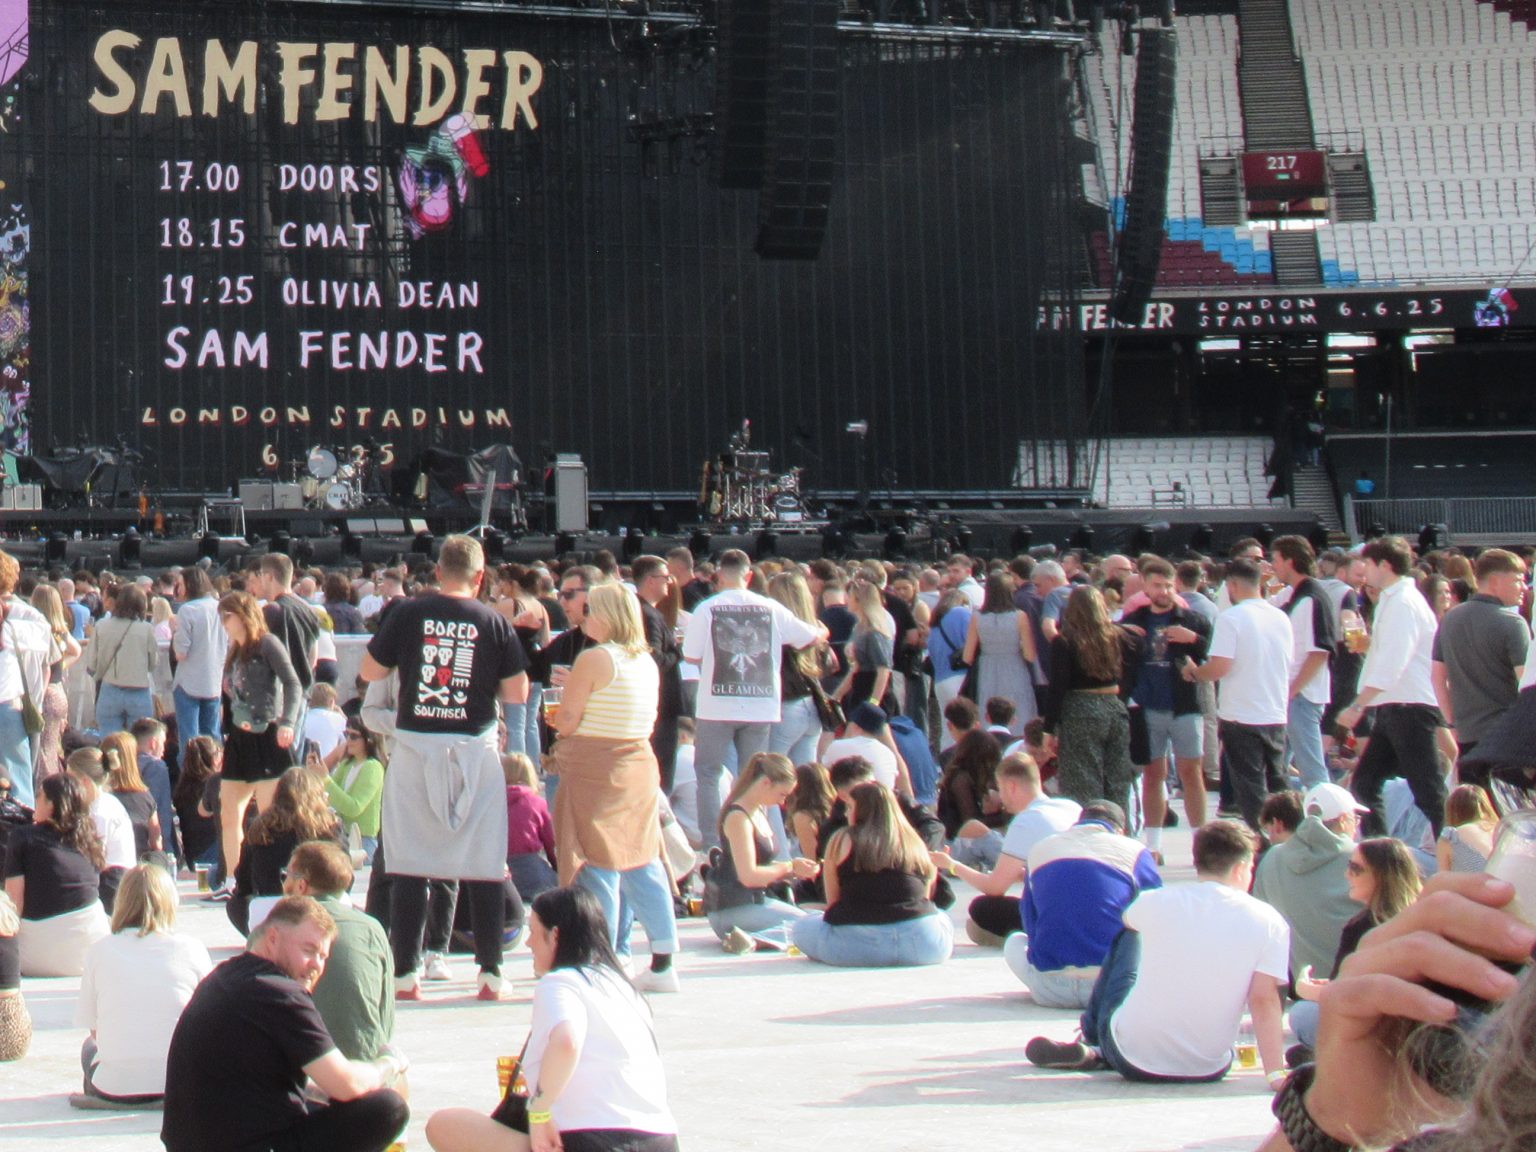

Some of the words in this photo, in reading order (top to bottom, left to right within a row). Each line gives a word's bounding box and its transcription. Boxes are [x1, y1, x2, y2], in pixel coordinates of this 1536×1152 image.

[89, 29, 258, 117] SAM
[276, 41, 544, 131] FENDER
[1267, 155, 1297, 170] 217
[159, 160, 241, 193] 17.00
[279, 163, 380, 193] DOORS
[160, 217, 246, 248] 18.15
[278, 222, 371, 250] CMAT
[161, 274, 255, 306] 19.25
[281, 278, 382, 308] OLIVIA
[397, 280, 479, 309] DEAN
[1199, 297, 1316, 312] LONDON
[1199, 313, 1318, 327] STADIUM
[163, 326, 269, 370] SAM
[299, 330, 484, 374] FENDER
[142, 406, 312, 426] LONDON
[330, 406, 513, 428] STADIUM
[424, 619, 479, 640] BORED
[712, 684, 774, 695] GLEAMING
[414, 704, 468, 720] SOUTHSEA
